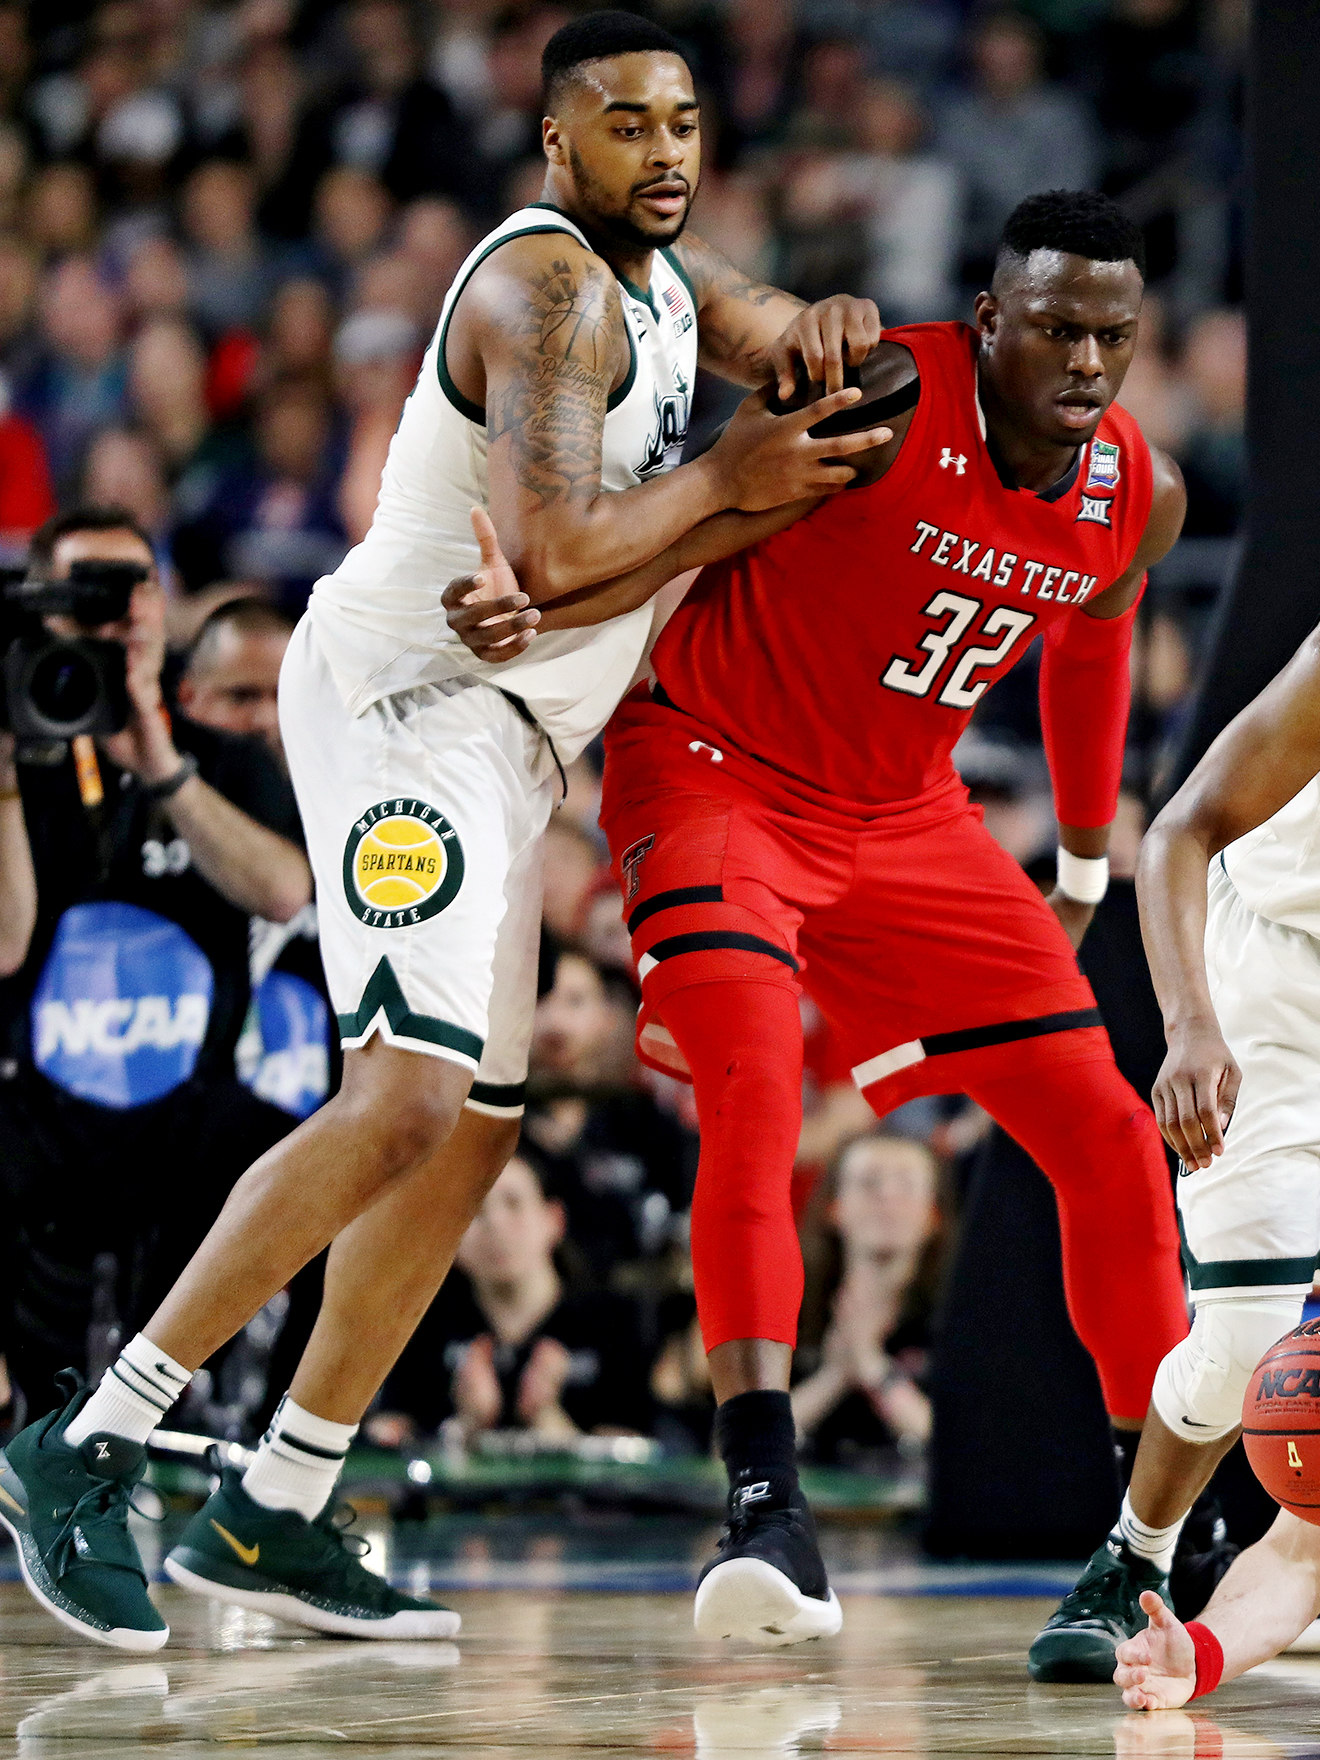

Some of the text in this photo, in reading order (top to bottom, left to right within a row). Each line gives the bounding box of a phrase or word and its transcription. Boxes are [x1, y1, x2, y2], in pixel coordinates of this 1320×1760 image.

[1089, 463, 1114, 475] FOUR
[1092, 453, 1115, 464] FINAL
[909, 519, 1098, 605] TEXAS TECH
[879, 589, 1037, 710] 32
[356, 799, 457, 841] MICHIGAN
[361, 853, 437, 875] SPARTANS
[361, 907, 421, 927] STATE
[38, 995, 208, 1060] NCAA
